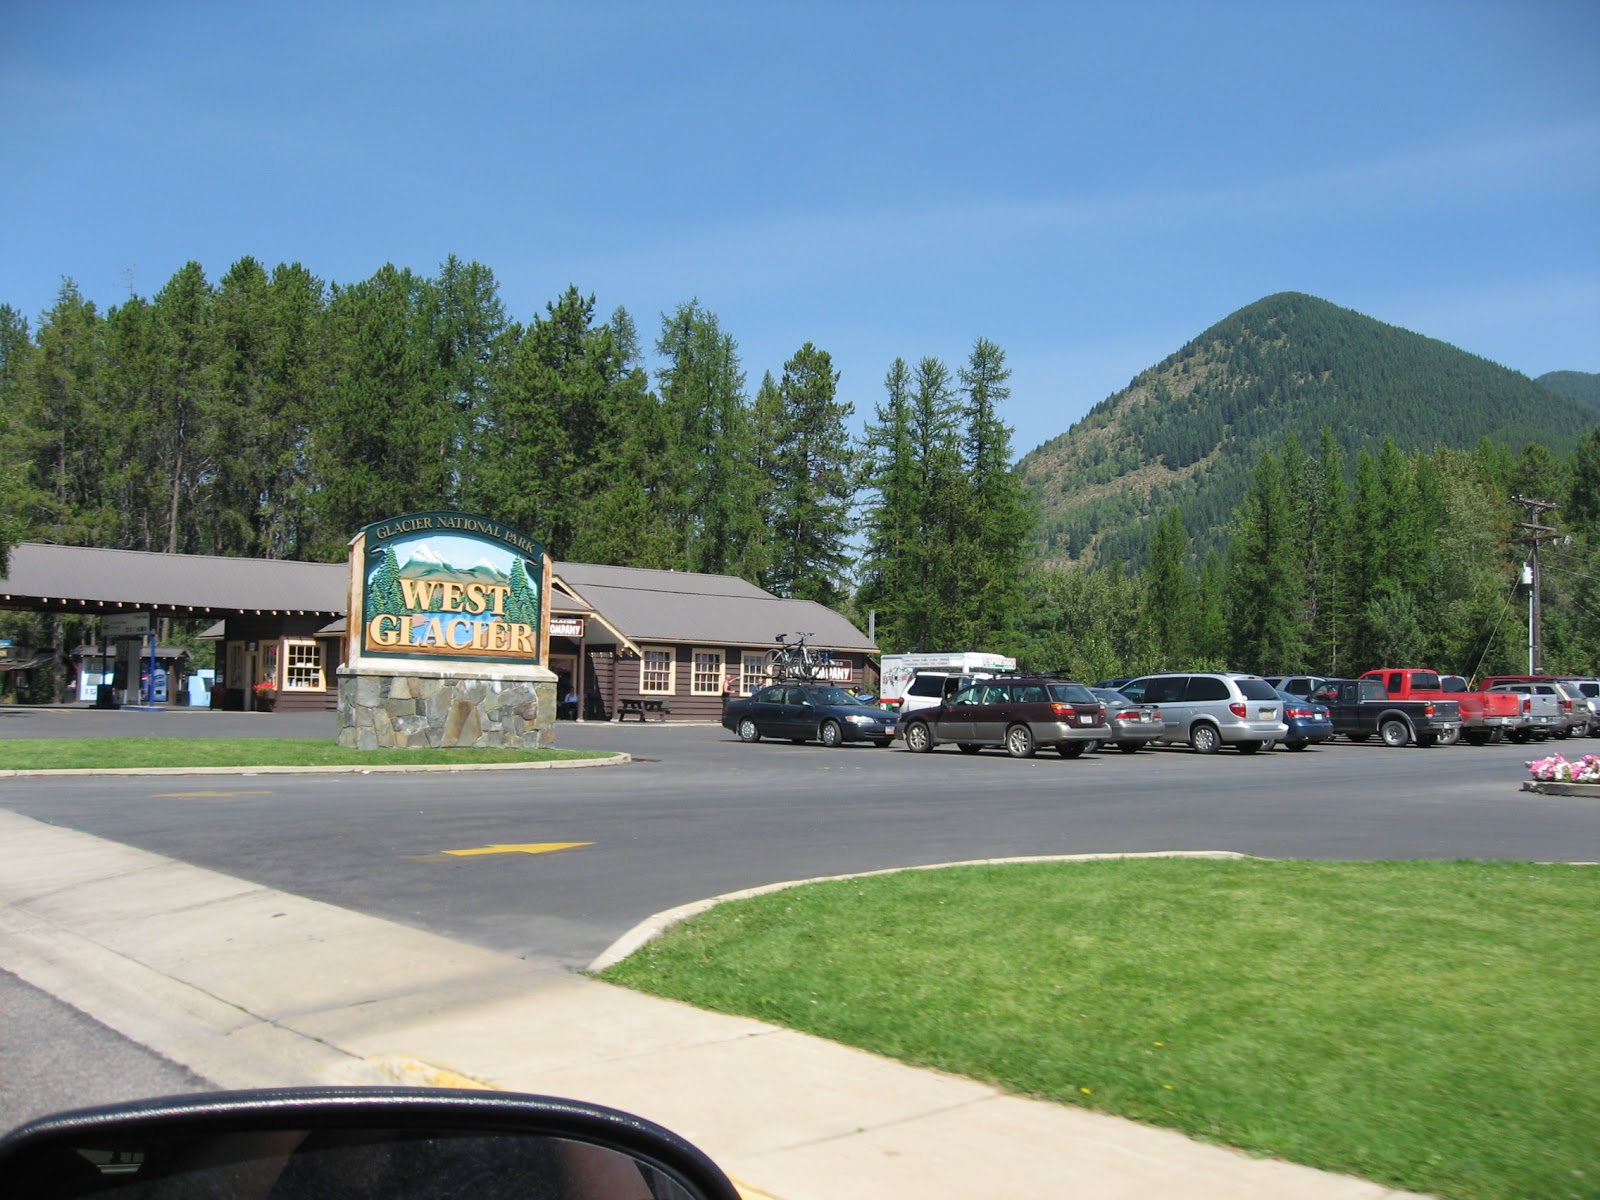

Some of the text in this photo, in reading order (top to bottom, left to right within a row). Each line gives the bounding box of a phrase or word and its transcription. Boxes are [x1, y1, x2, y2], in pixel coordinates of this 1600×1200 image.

[376, 516, 535, 554] GLACIER NATIONAL PARK
[400, 578, 512, 616] WEST
[369, 613, 533, 653] GLACIER
[550, 624, 581, 635] OMPANY
